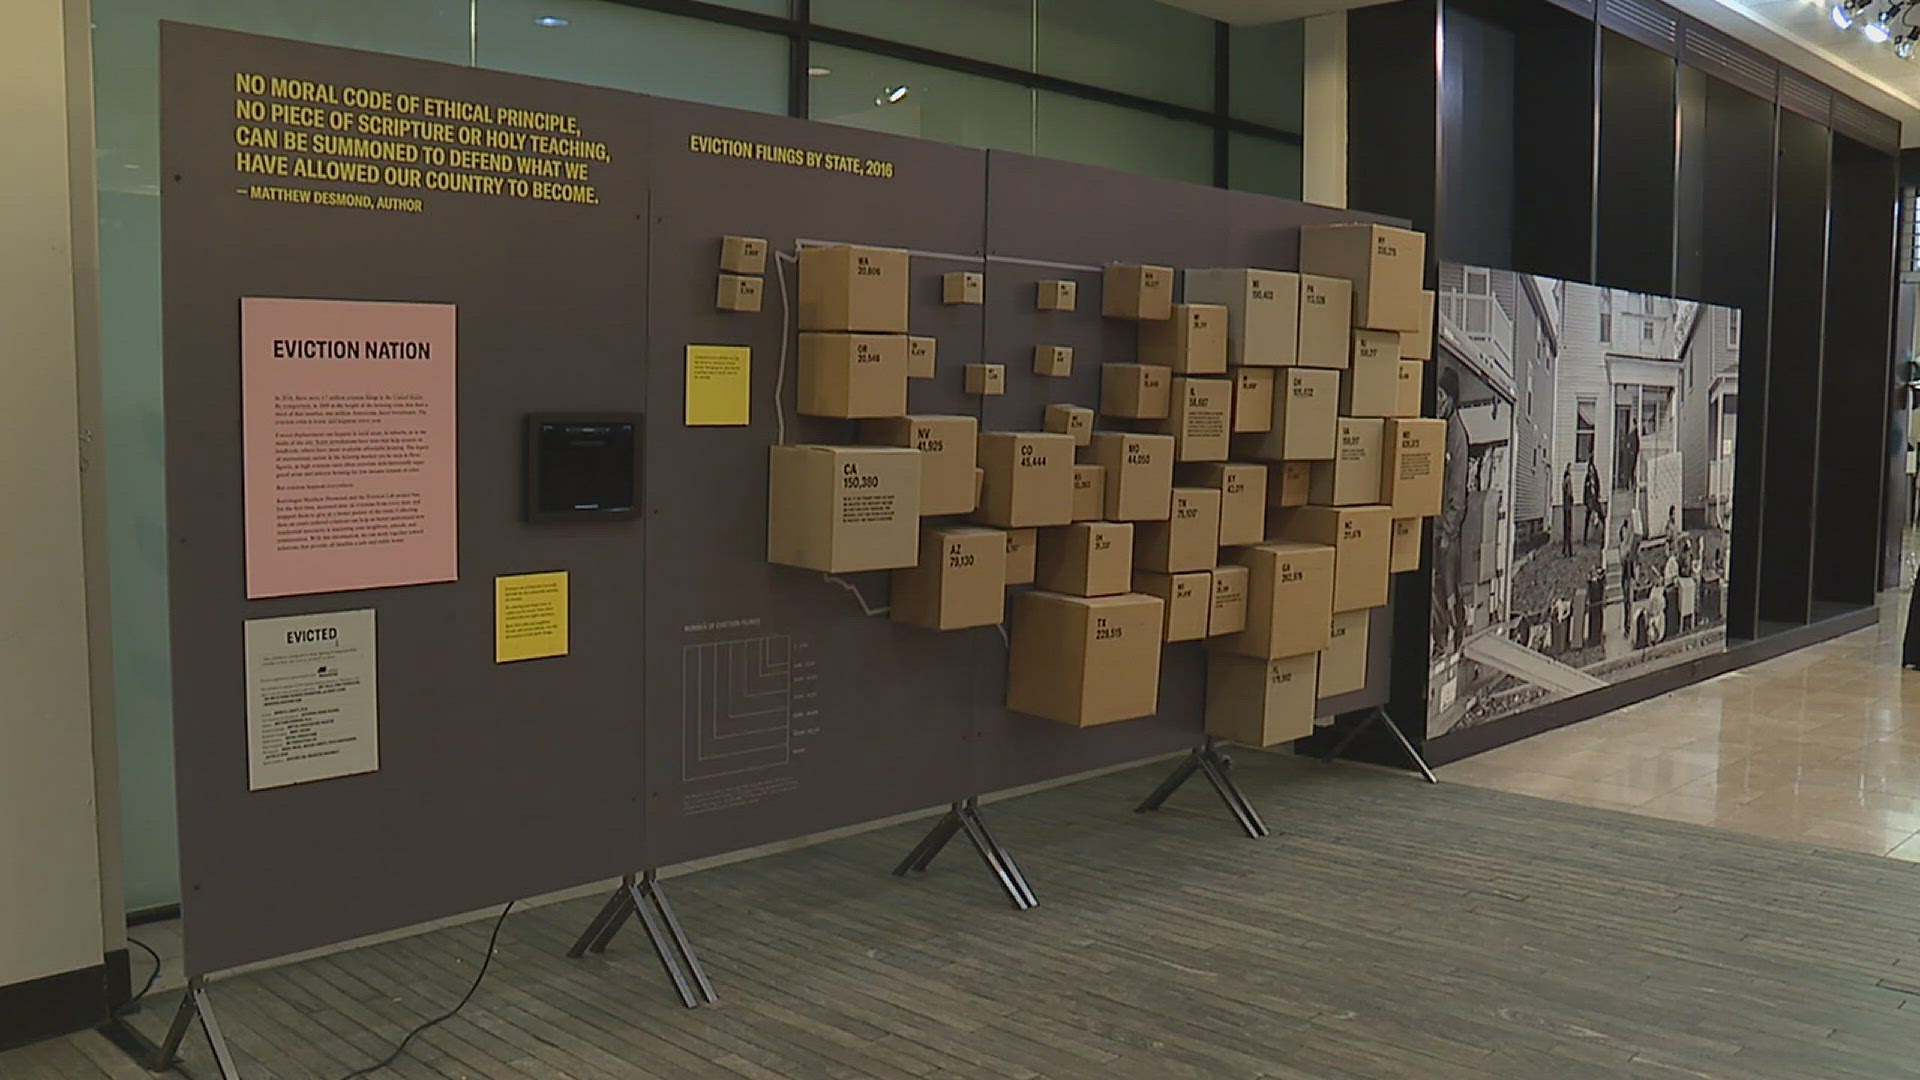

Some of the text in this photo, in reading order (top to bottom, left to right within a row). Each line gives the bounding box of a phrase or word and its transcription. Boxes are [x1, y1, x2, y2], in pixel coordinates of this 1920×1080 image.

[235, 73, 581, 137] NO MORAL CODE OF ETHICAL PRINCIPLE,
[235, 99, 611, 163] NO PIECE OF SCRIPTURE OR HOLY TEACHING,
[236, 126, 588, 180] CAN BE SUMMONED TO DEFEND WHAT WE
[690, 134, 893, 178] EVICTION FILINGS BY STATE, 2016
[237, 151, 599, 204] HAVE ALLOWED OUR COUNTRY TO BECOME.
[251, 186, 311, 203] MATTHEW
[314, 191, 374, 210] DESMOND,
[376, 196, 422, 212] AUTHOR
[274, 340, 430, 359] EVICTION NATION
[857, 344, 868, 353] OR
[918, 429, 931, 439] NV
[1021, 445, 1033, 456] CO
[1129, 444, 1140, 453] MO
[1021, 457, 1047, 467] 45,444
[843, 463, 857, 475] CA
[950, 544, 961, 555] AZ
[1097, 619, 1106, 627] TX
[287, 628, 337, 643] EVICTED
